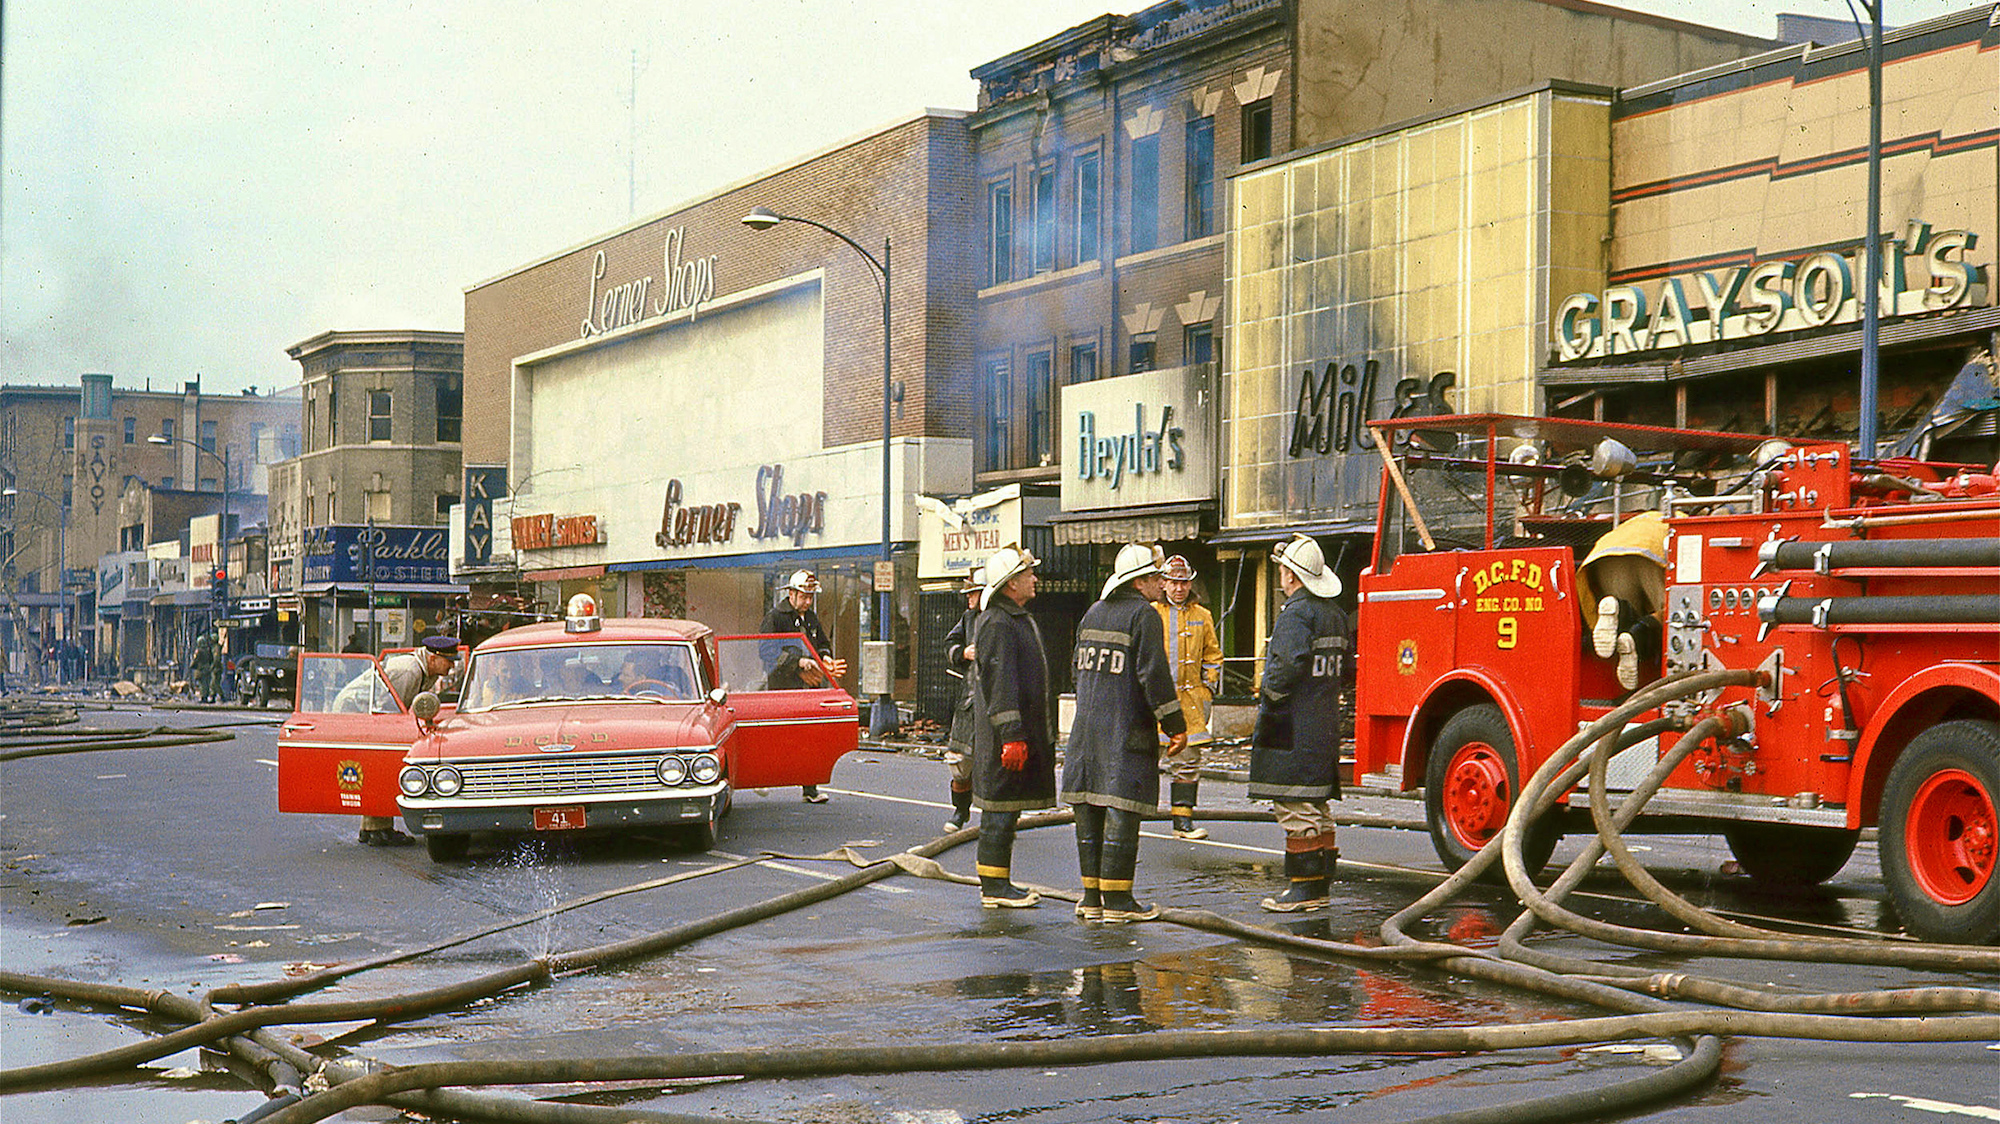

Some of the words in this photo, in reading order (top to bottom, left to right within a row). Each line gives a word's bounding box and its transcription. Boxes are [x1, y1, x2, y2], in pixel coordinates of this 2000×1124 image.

[580, 249, 653, 338] Lerner
[655, 225, 718, 322] Shops
[1554, 218, 1979, 361] GRAYSON'S
[1077, 402, 1184, 490] Beyda's
[91, 435, 106, 516] SAVOY
[468, 473, 491, 560] KAY
[556, 515, 597, 547] SHOES
[655, 478, 742, 549] Lerner
[747, 463, 829, 547] Shops
[943, 531, 970, 552] MEN'S
[1472, 559, 1545, 595] D.C.F.D.
[1475, 597, 1501, 612] ENG.
[1502, 597, 1522, 612] CO.
[1524, 597, 1545, 612] NO.
[1496, 616, 1518, 649] 9
[551, 812, 569, 824] 41
